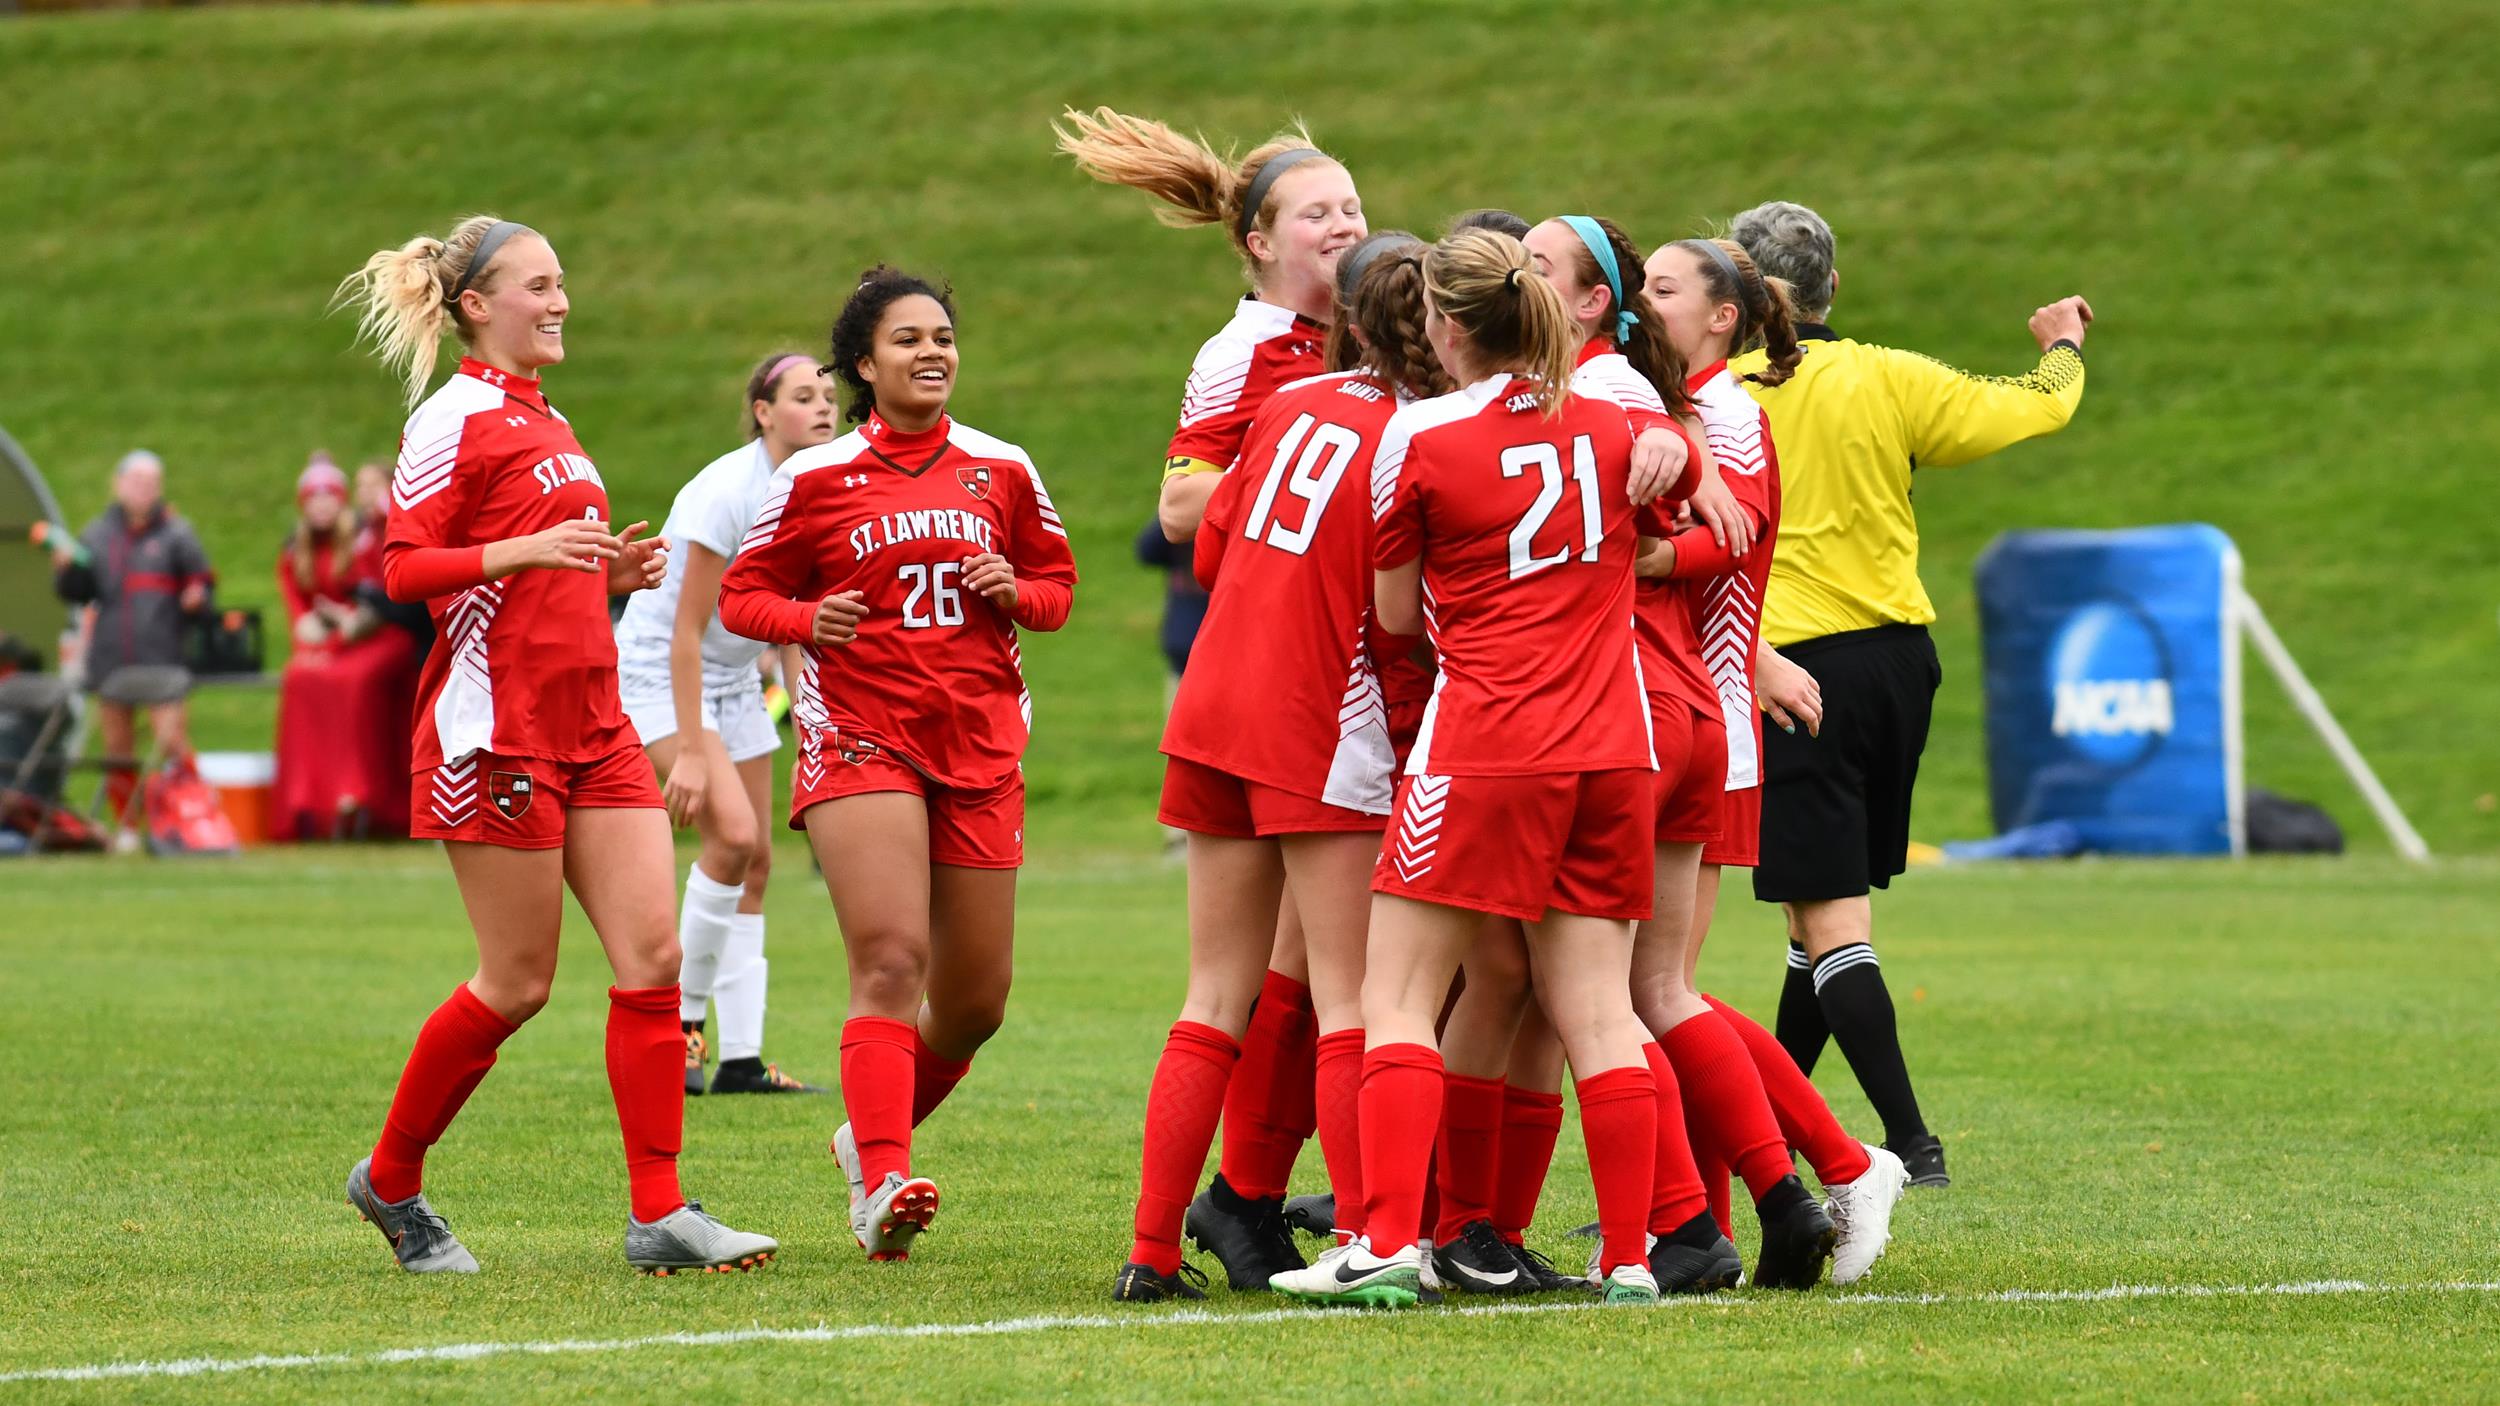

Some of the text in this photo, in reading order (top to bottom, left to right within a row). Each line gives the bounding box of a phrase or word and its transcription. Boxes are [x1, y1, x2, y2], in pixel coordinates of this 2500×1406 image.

[1336, 380, 1386, 403] SAINTS
[532, 457, 566, 495] ST.
[1243, 411, 1362, 556] 19
[850, 509, 993, 561] ST. LAWRENCE
[1500, 434, 1605, 580] 21
[898, 562, 965, 628] 26
[2051, 679, 2173, 737] NCAA
